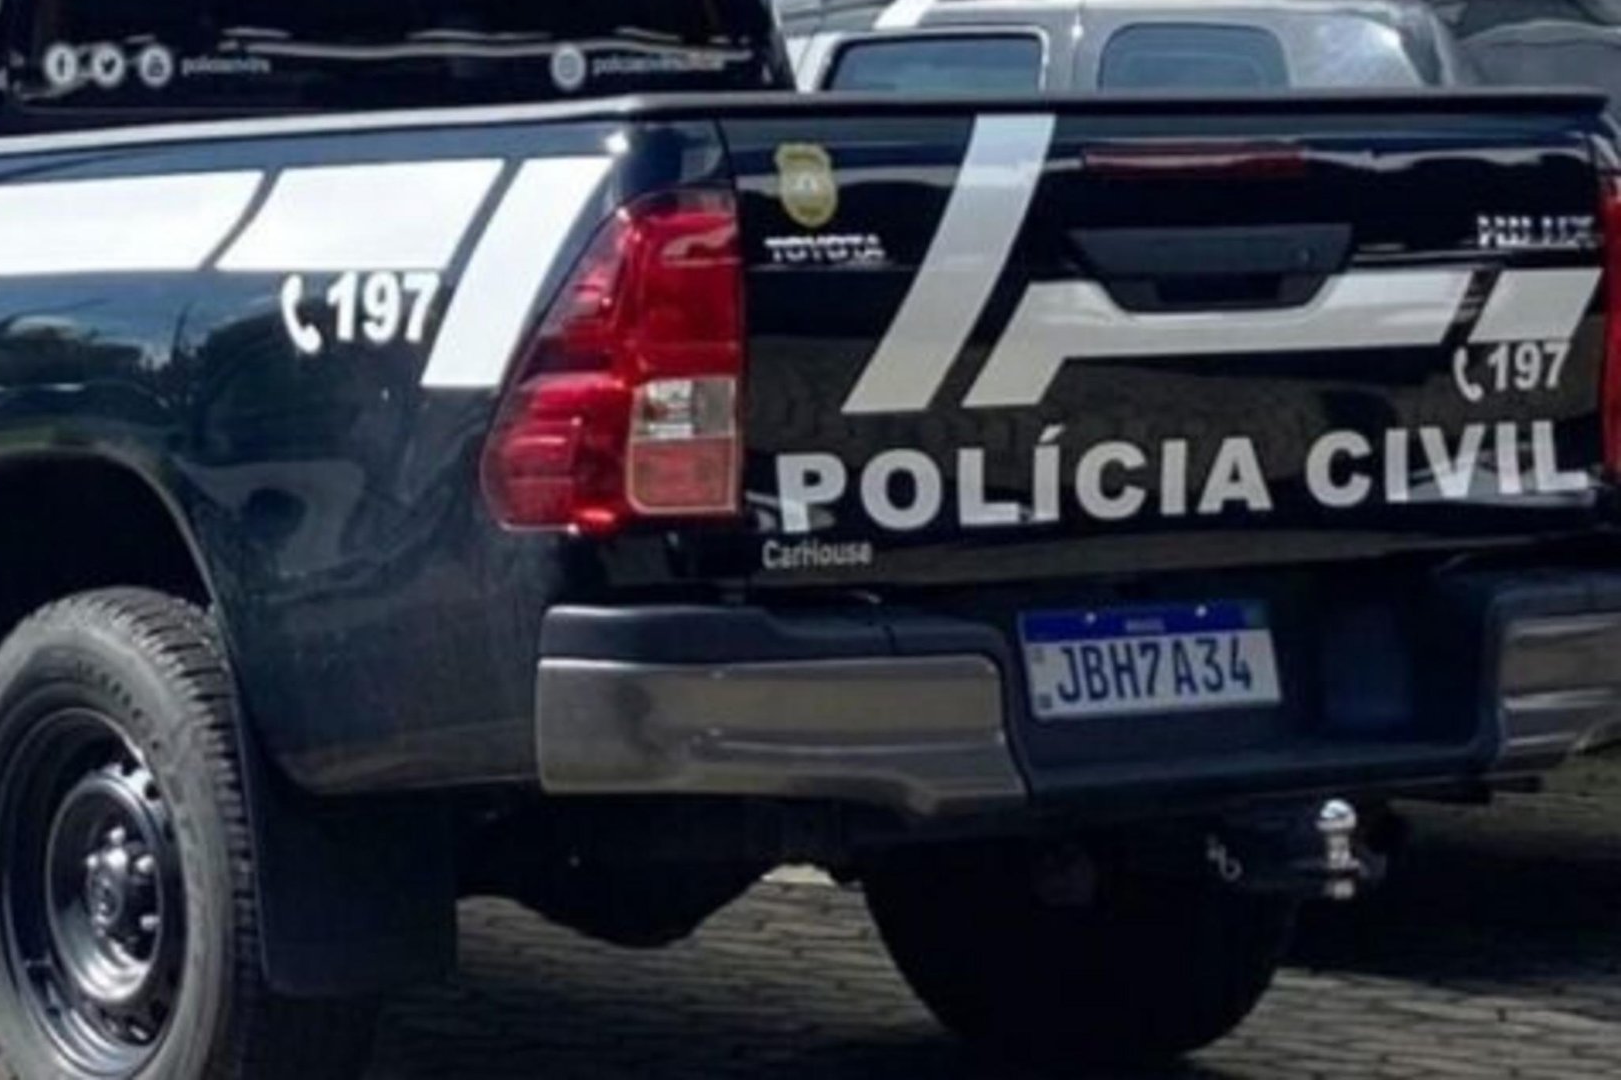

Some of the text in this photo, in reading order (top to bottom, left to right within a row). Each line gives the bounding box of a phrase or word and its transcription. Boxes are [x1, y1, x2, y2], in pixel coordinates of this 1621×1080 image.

[764, 233, 885, 262] TOYOTA
[323, 271, 441, 343] 197
[1487, 341, 1572, 392] 197
[776, 417, 1592, 534] POLÍCIA CIVIL
[1056, 634, 1254, 704] JBH7A34
